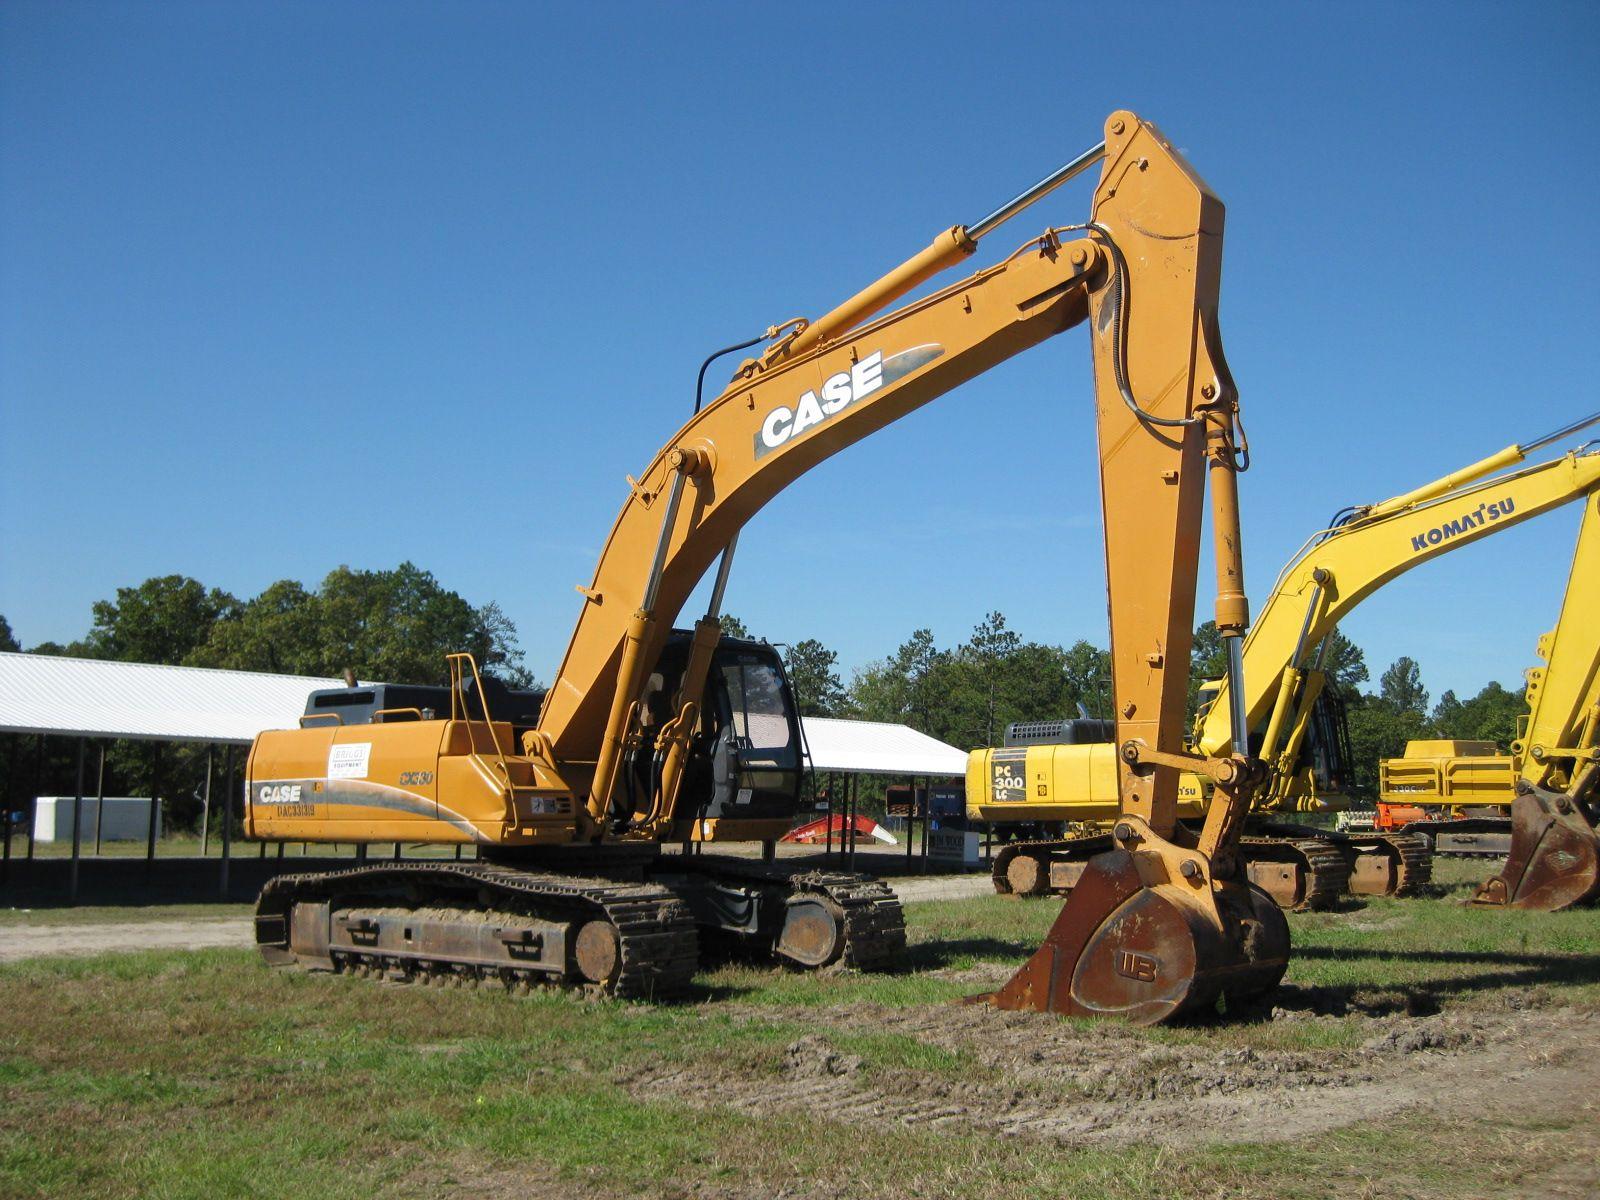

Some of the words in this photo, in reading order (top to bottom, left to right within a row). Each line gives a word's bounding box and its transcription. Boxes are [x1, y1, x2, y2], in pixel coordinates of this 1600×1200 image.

[761, 350, 883, 449] CASE
[1411, 497, 1515, 551] KOMATSU
[994, 765, 1011, 777] PC
[994, 777, 1024, 788] 300
[260, 785, 302, 803] CASE
[994, 789, 1008, 800] LC
